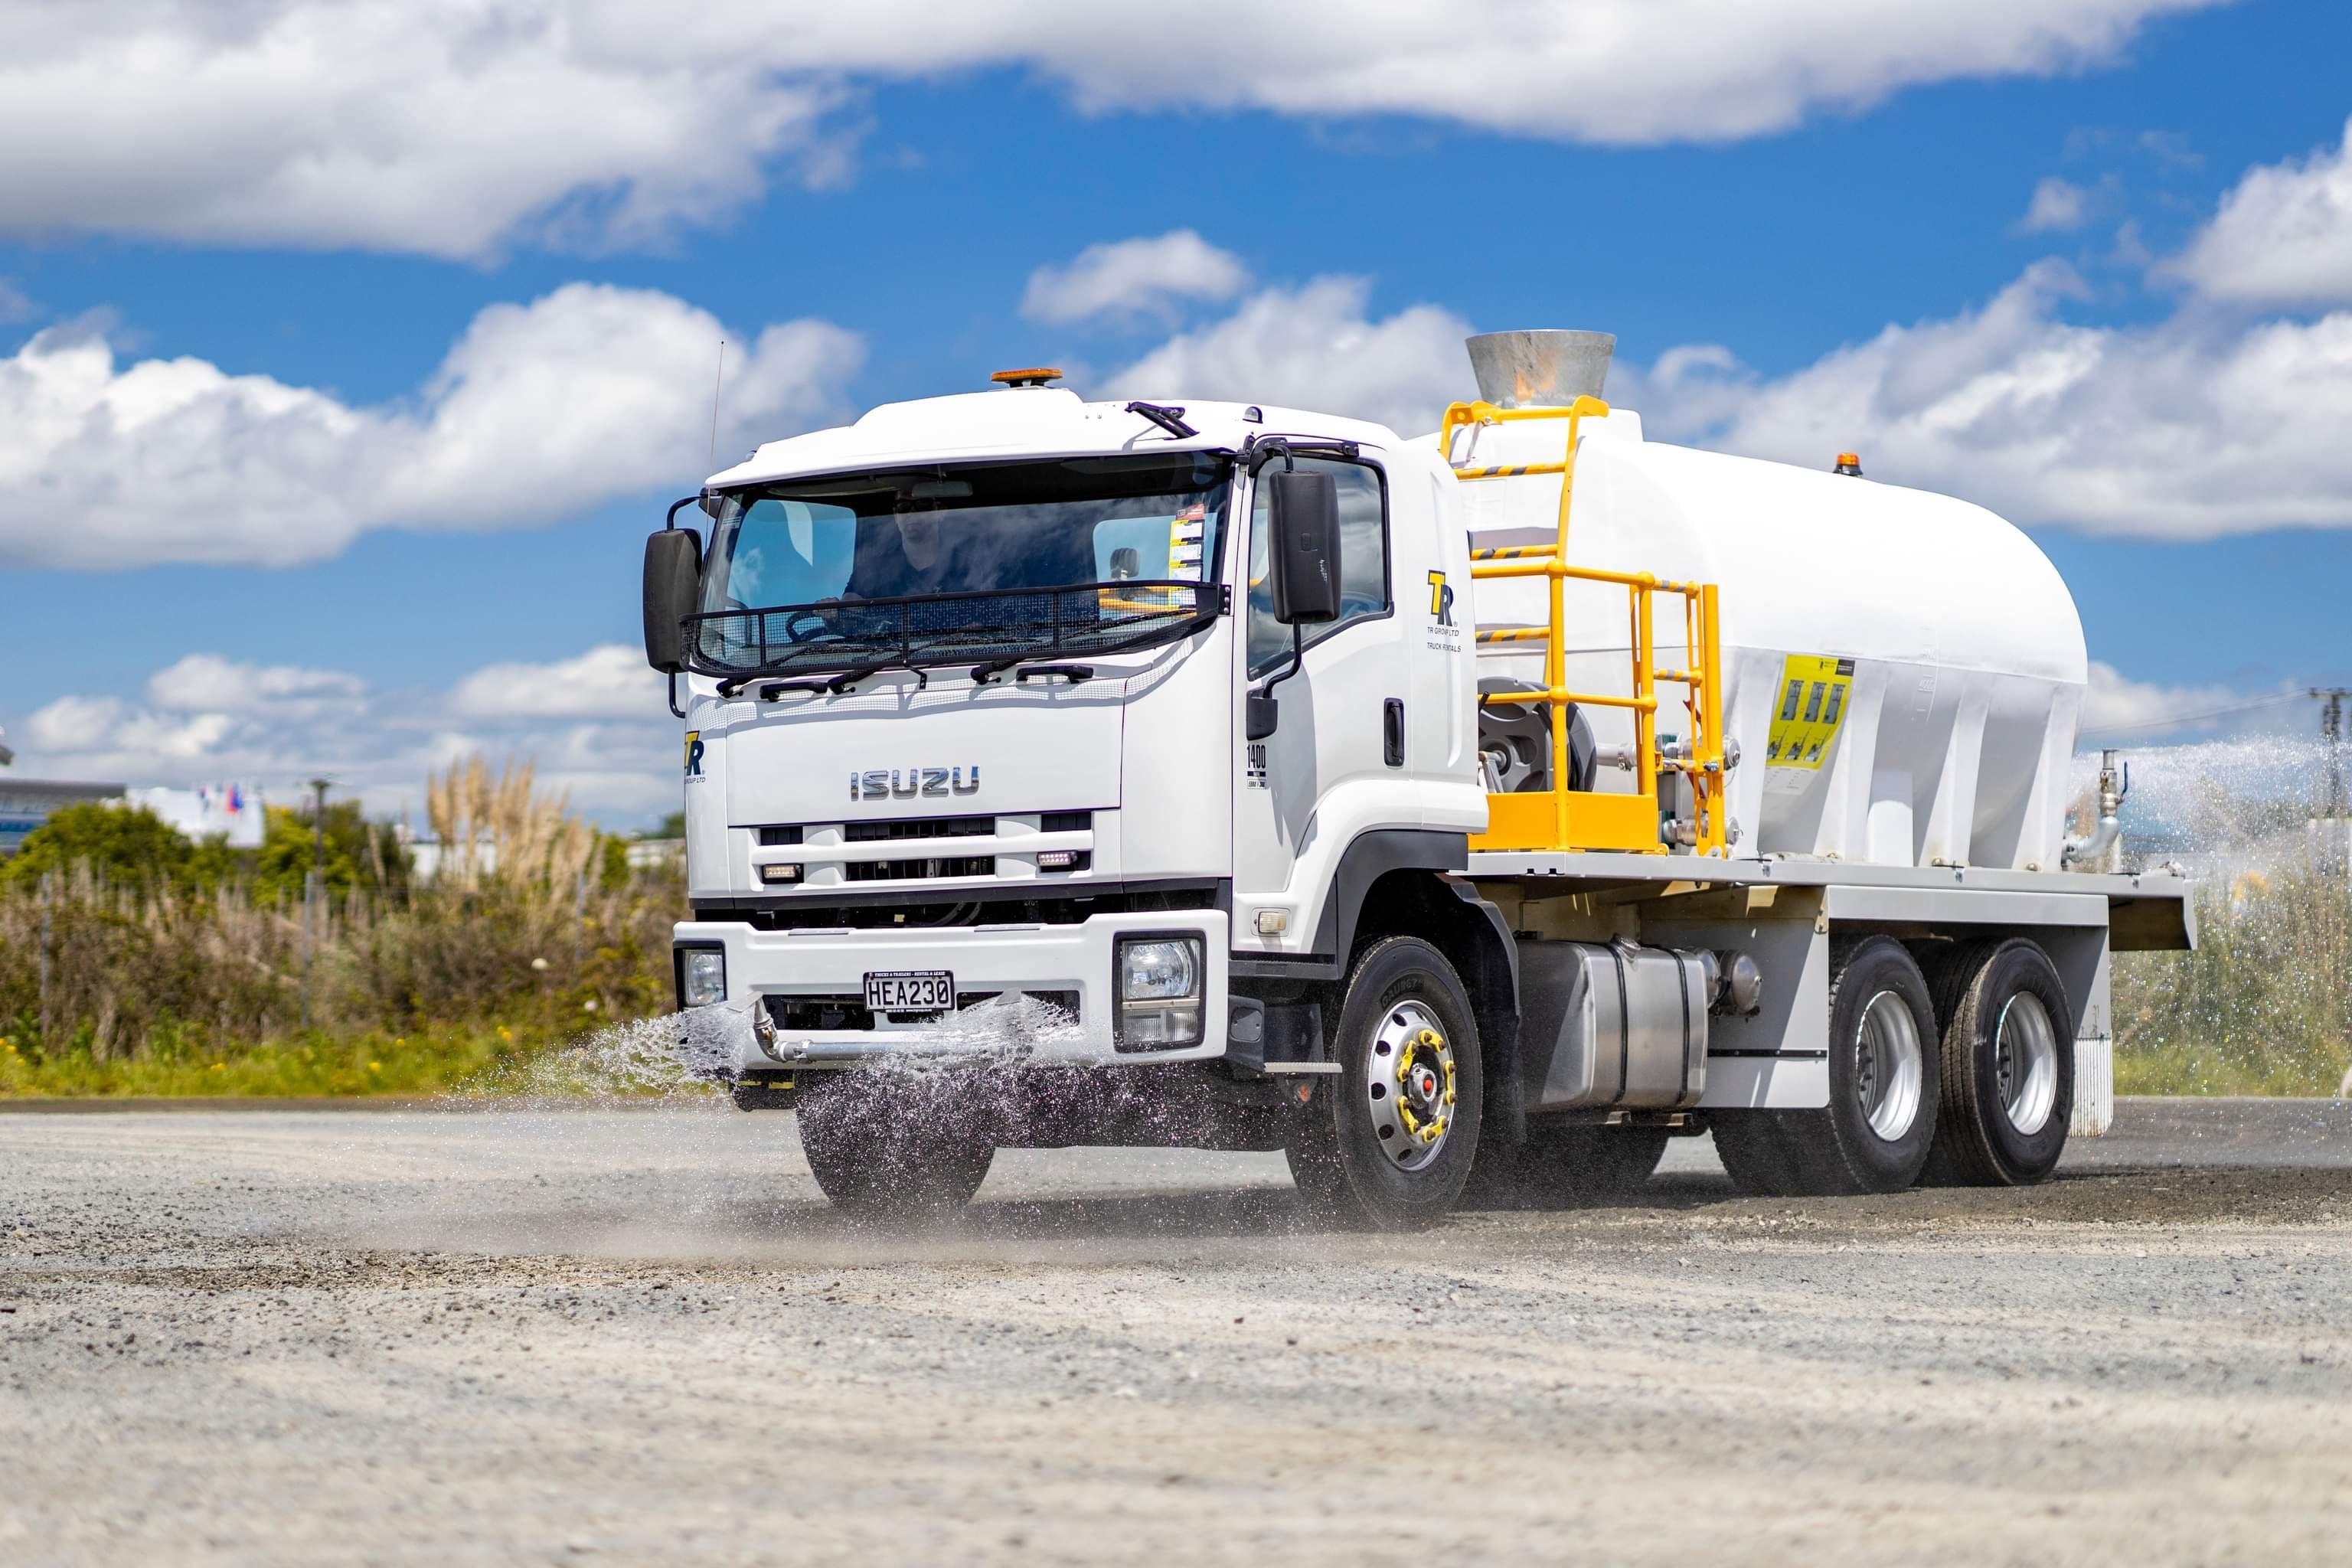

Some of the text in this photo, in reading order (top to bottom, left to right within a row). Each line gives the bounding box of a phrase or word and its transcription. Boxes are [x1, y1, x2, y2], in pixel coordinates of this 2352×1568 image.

[1428, 570, 1454, 626] TR
[1427, 626, 1433, 635] TR
[1247, 744, 1266, 769] 1400
[851, 766, 979, 802] ISUZU
[868, 980, 949, 1005] HEA230
